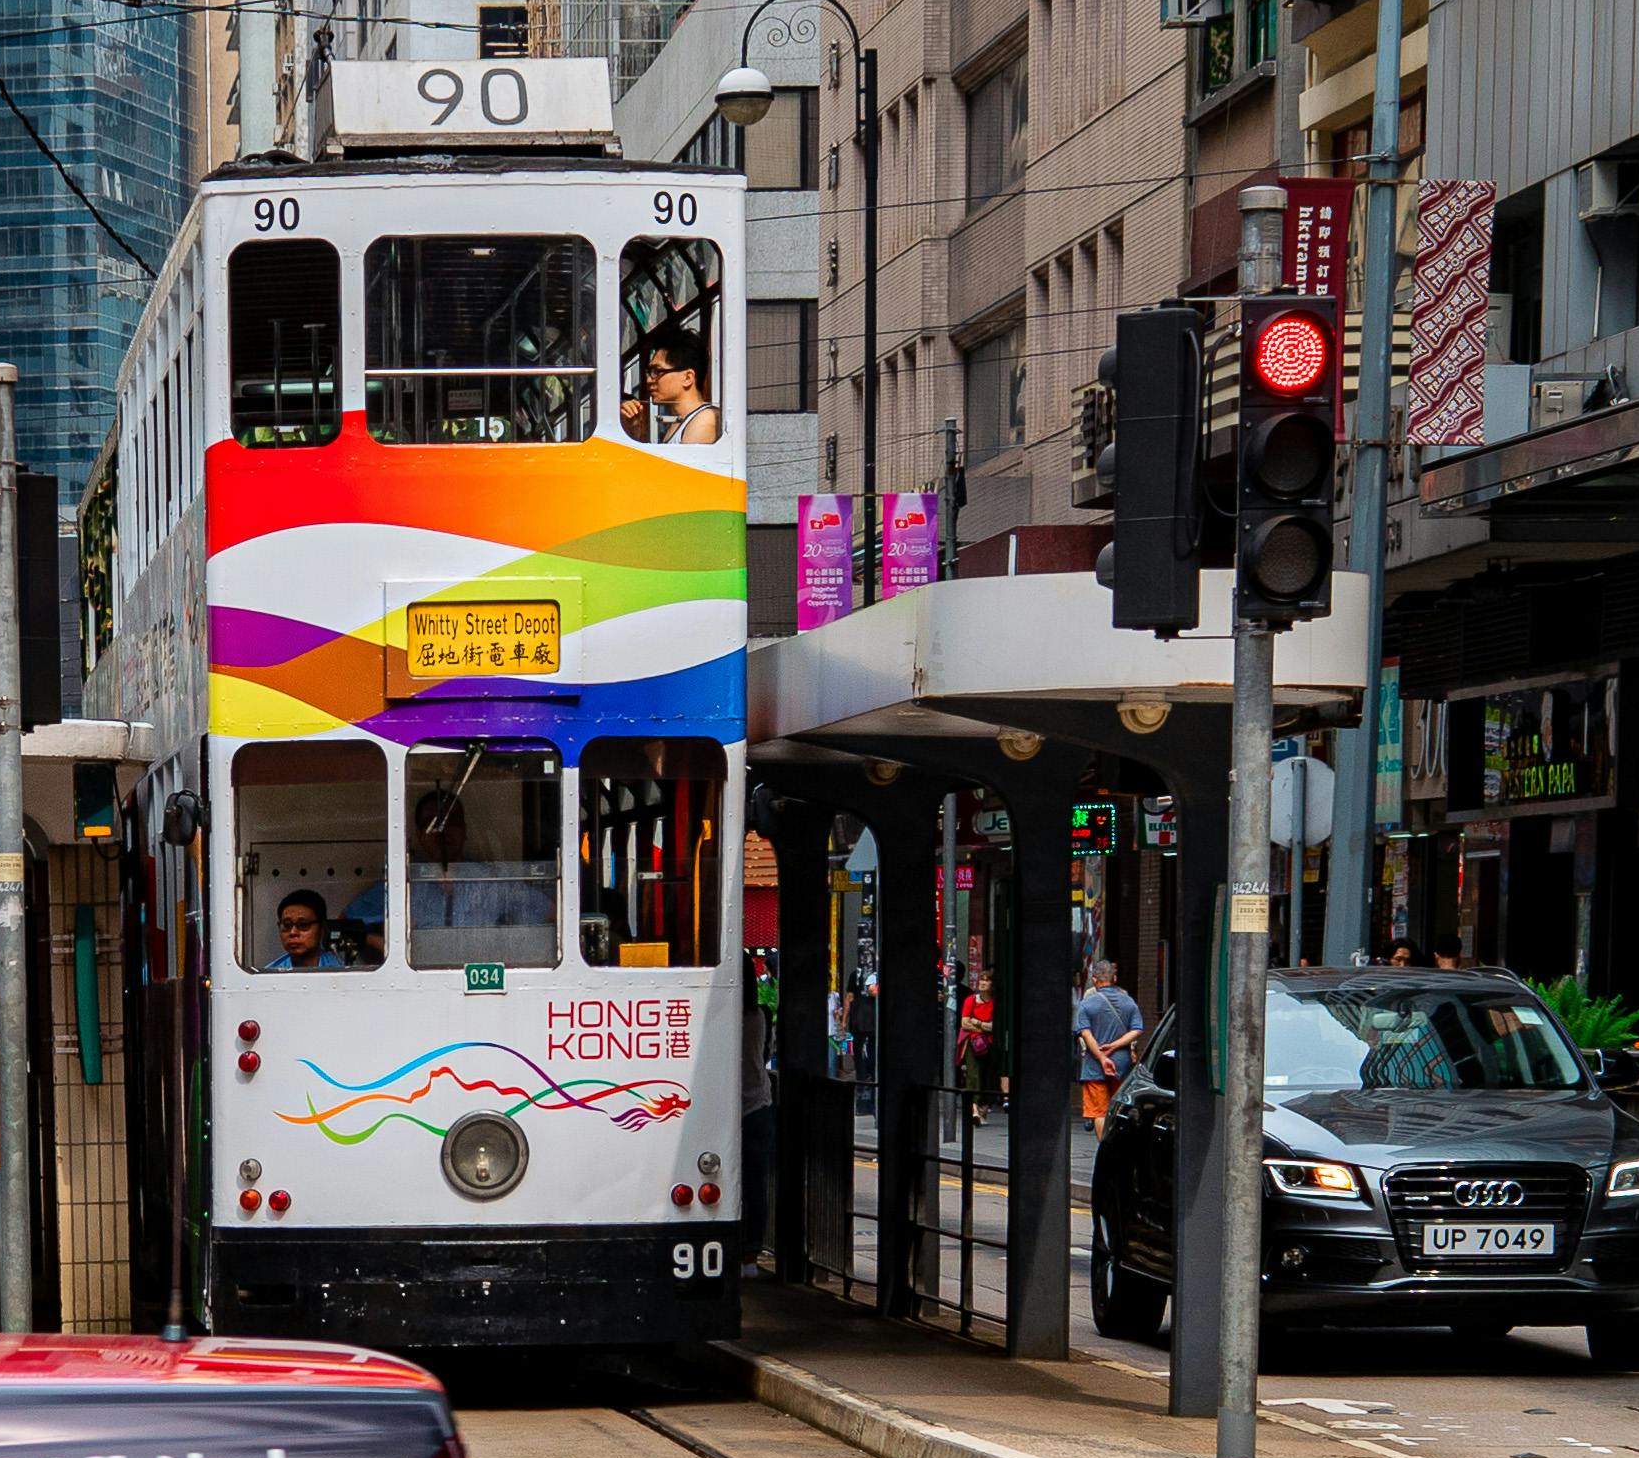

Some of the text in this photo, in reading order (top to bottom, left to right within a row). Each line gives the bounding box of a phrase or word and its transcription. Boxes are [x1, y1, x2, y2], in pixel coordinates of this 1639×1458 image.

[418, 68, 528, 126] 90
[254, 197, 300, 232] 90
[653, 191, 697, 226] 90
[415, 612, 556, 640] Whitty Street Depot
[416, 641, 555, 668] 屈地街電車廠
[1547, 762, 1576, 795] PAPA
[470, 967, 500, 986] 034
[548, 999, 692, 1029] HONG 香
[548, 1030, 691, 1060] KONG 港
[1432, 1228, 1545, 1250] UP 7049
[672, 1241, 723, 1279] 90
